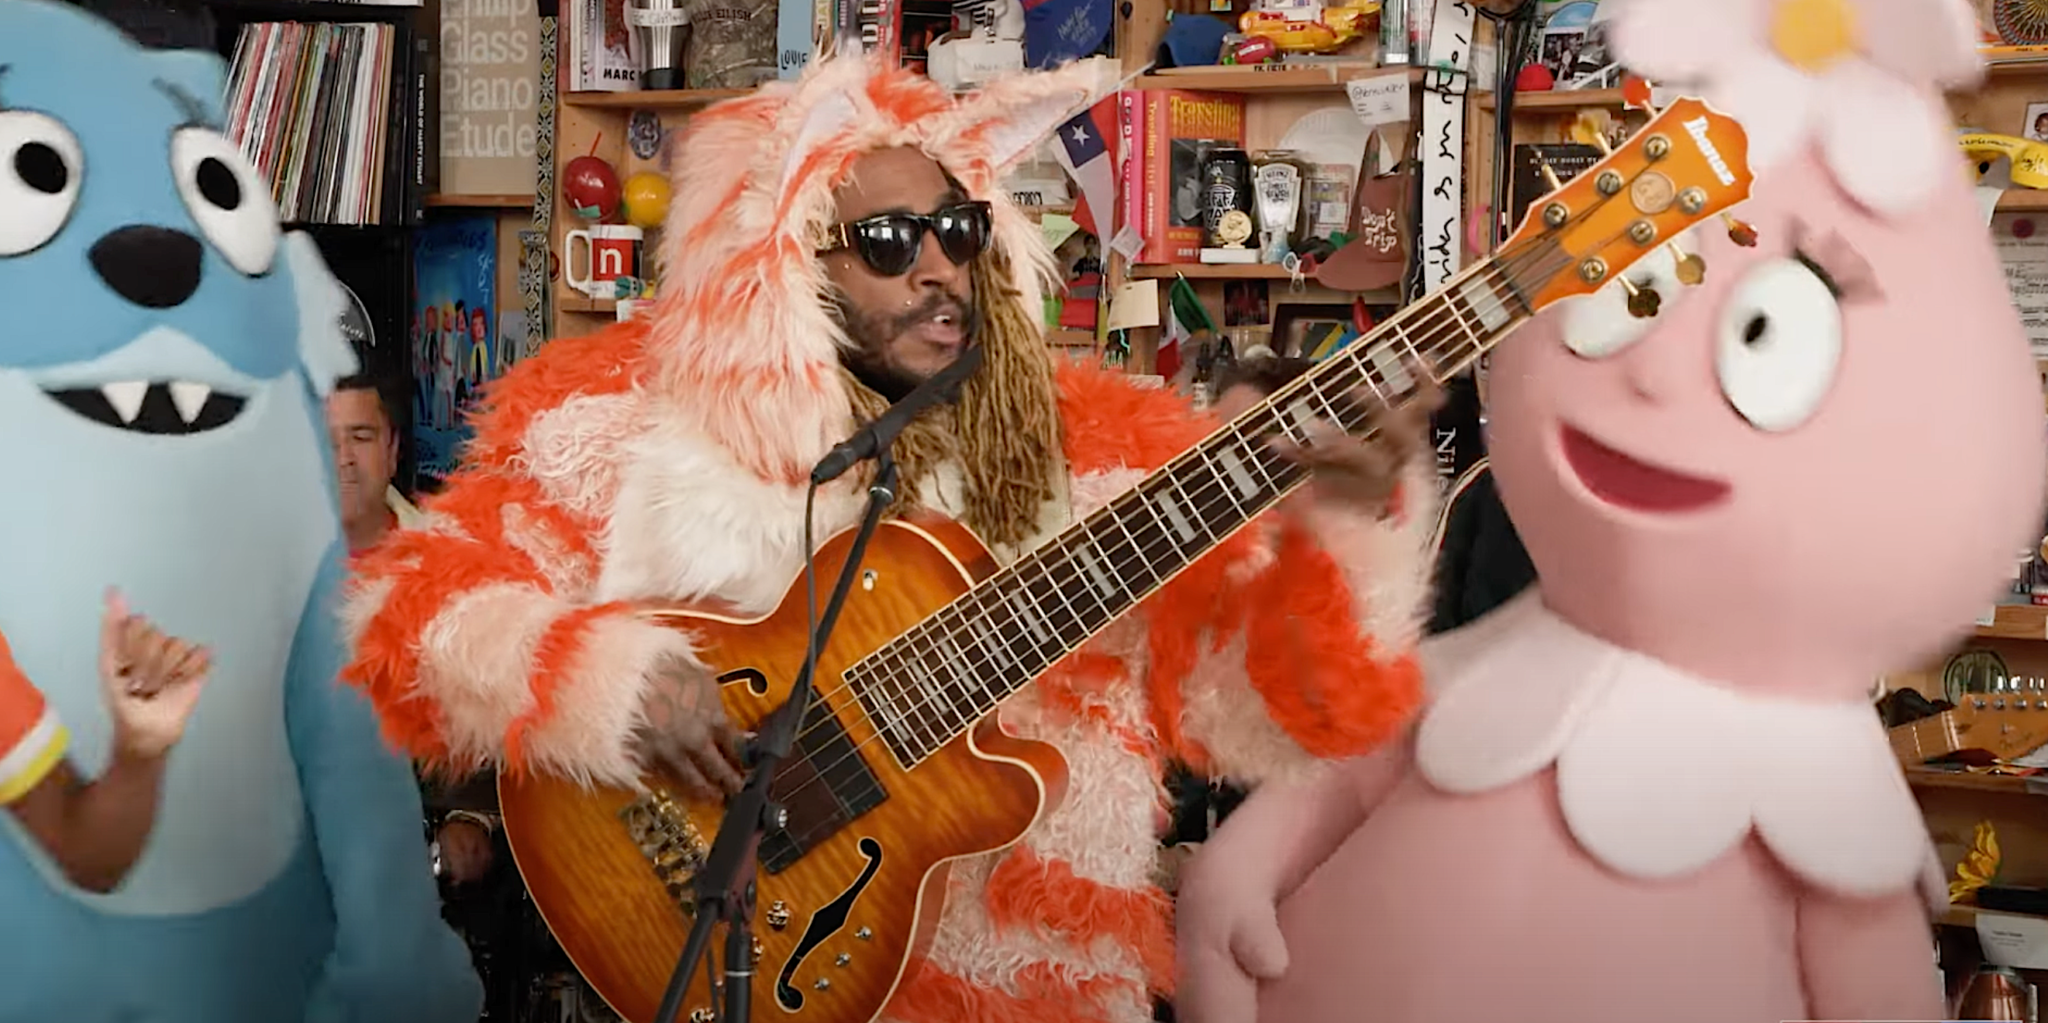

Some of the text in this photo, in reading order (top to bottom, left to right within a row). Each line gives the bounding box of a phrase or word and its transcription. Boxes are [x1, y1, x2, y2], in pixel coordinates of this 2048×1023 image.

[441, 20, 529, 63] Glass
[441, 67, 533, 111] Piano
[603, 68, 635, 80] MARC
[1170, 96, 1241, 127] Traveling
[1148, 101, 1158, 156] Traveling
[1682, 115, 1736, 186] Ibanez
[1361, 206, 1397, 232] Don't
[1365, 228, 1397, 253] Trip
[600, 248, 622, 274] n
